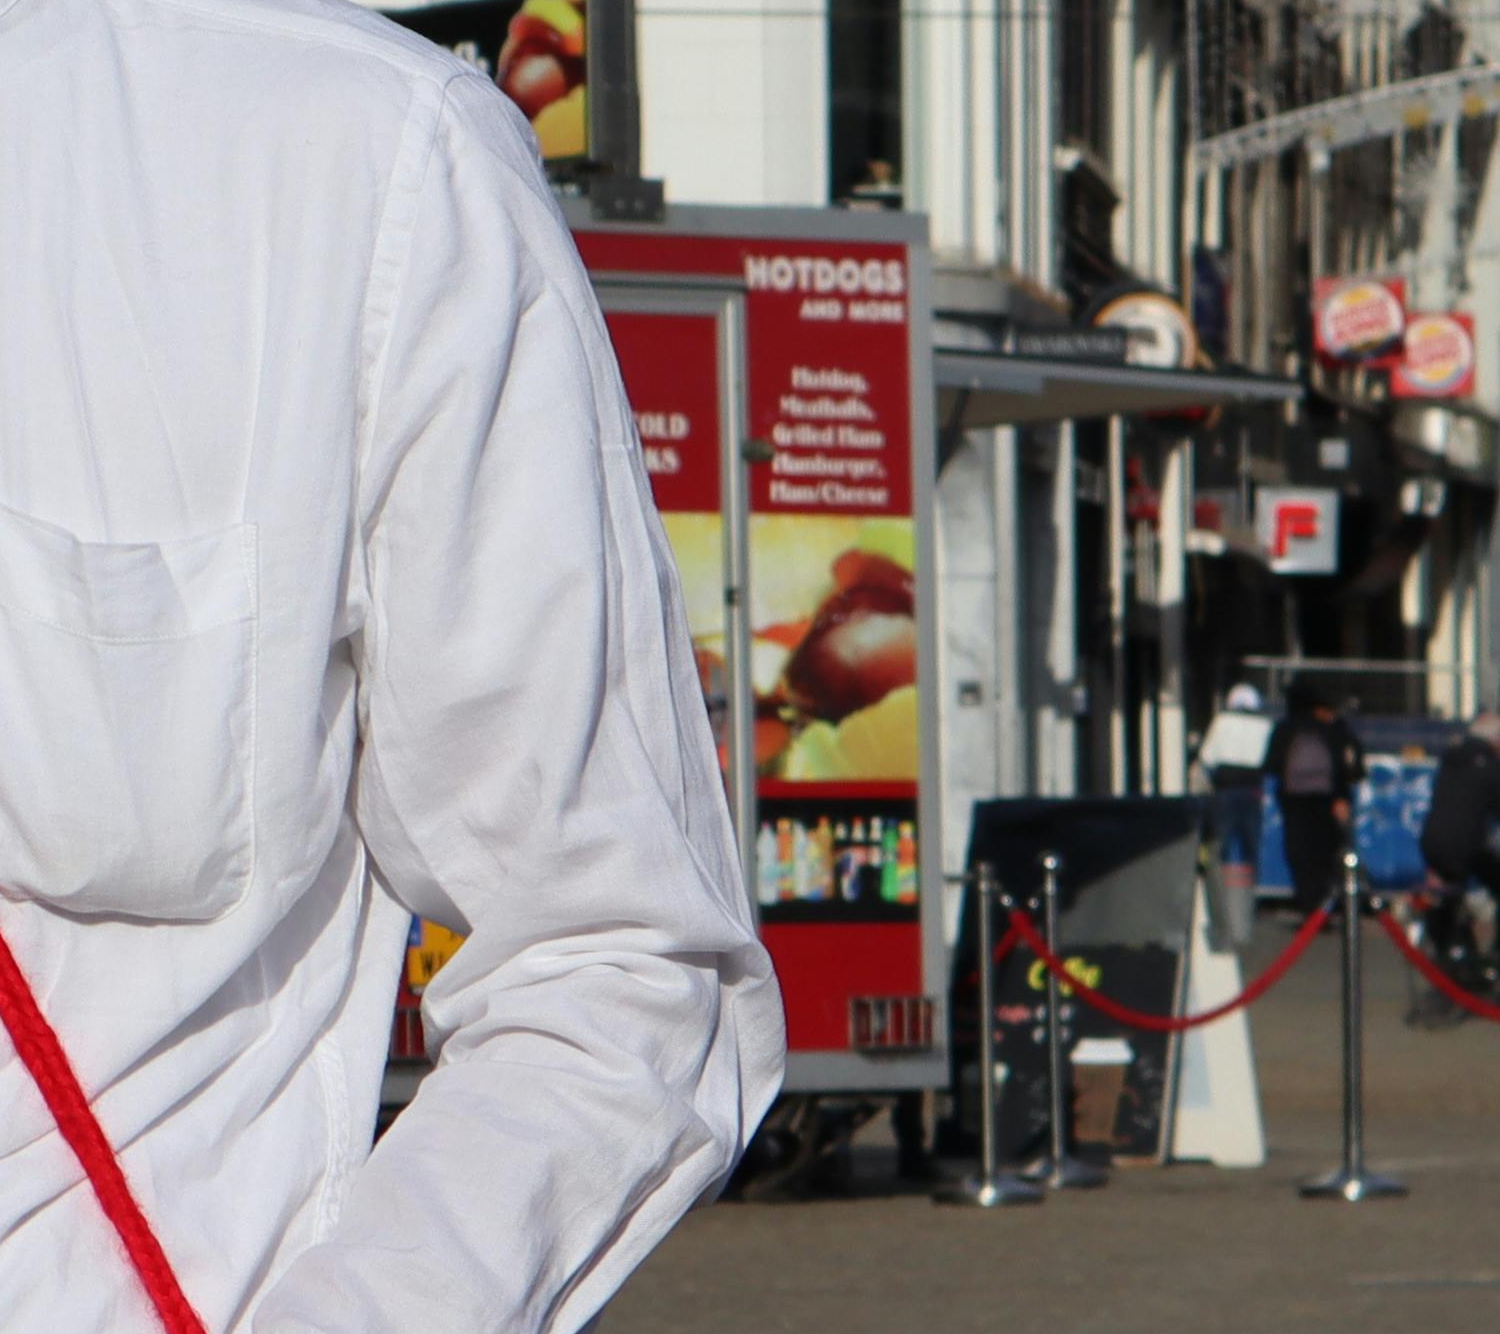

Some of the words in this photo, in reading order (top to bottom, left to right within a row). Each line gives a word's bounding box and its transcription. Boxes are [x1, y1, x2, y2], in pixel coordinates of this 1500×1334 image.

[745, 256, 905, 294] HOTDOGS
[801, 299, 843, 321] AND
[849, 301, 904, 323] MORE
[633, 411, 691, 439] OLD
